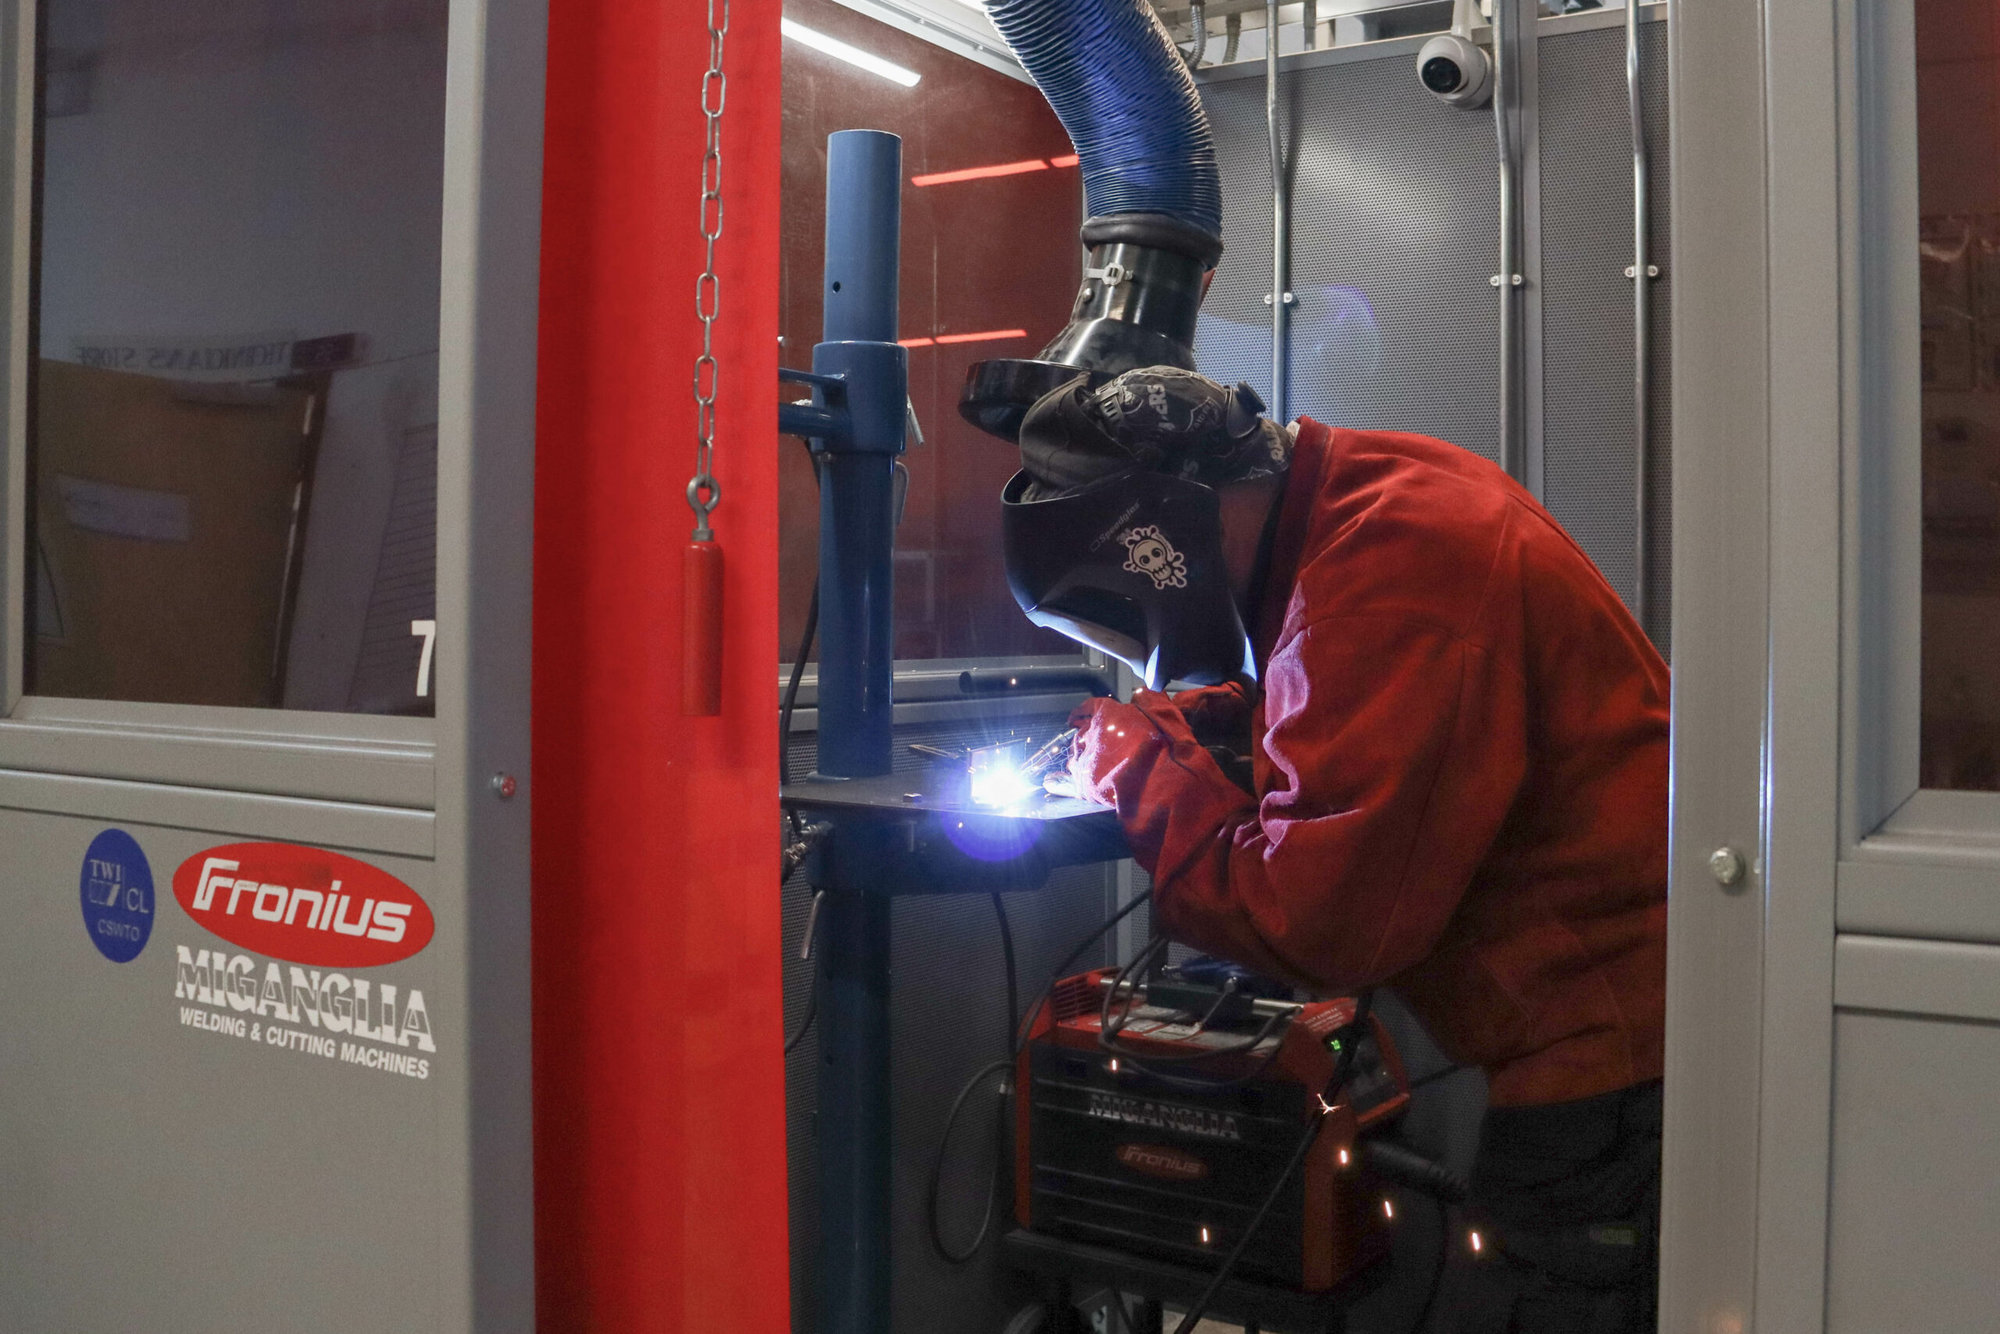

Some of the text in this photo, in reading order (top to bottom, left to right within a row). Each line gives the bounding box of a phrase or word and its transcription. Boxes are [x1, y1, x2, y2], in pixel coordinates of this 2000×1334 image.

[411, 619, 437, 697] 7
[88, 859, 122, 882] TWI
[126, 887, 150, 914] CL
[192, 857, 413, 943] Fronius
[174, 945, 436, 1053] MIGANGLIA
[180, 1006, 430, 1080] WELDING & CUTTING MACHINES
[1088, 1093, 1241, 1141] MIGANGLIA
[1123, 1146, 1202, 1175] Fronius
